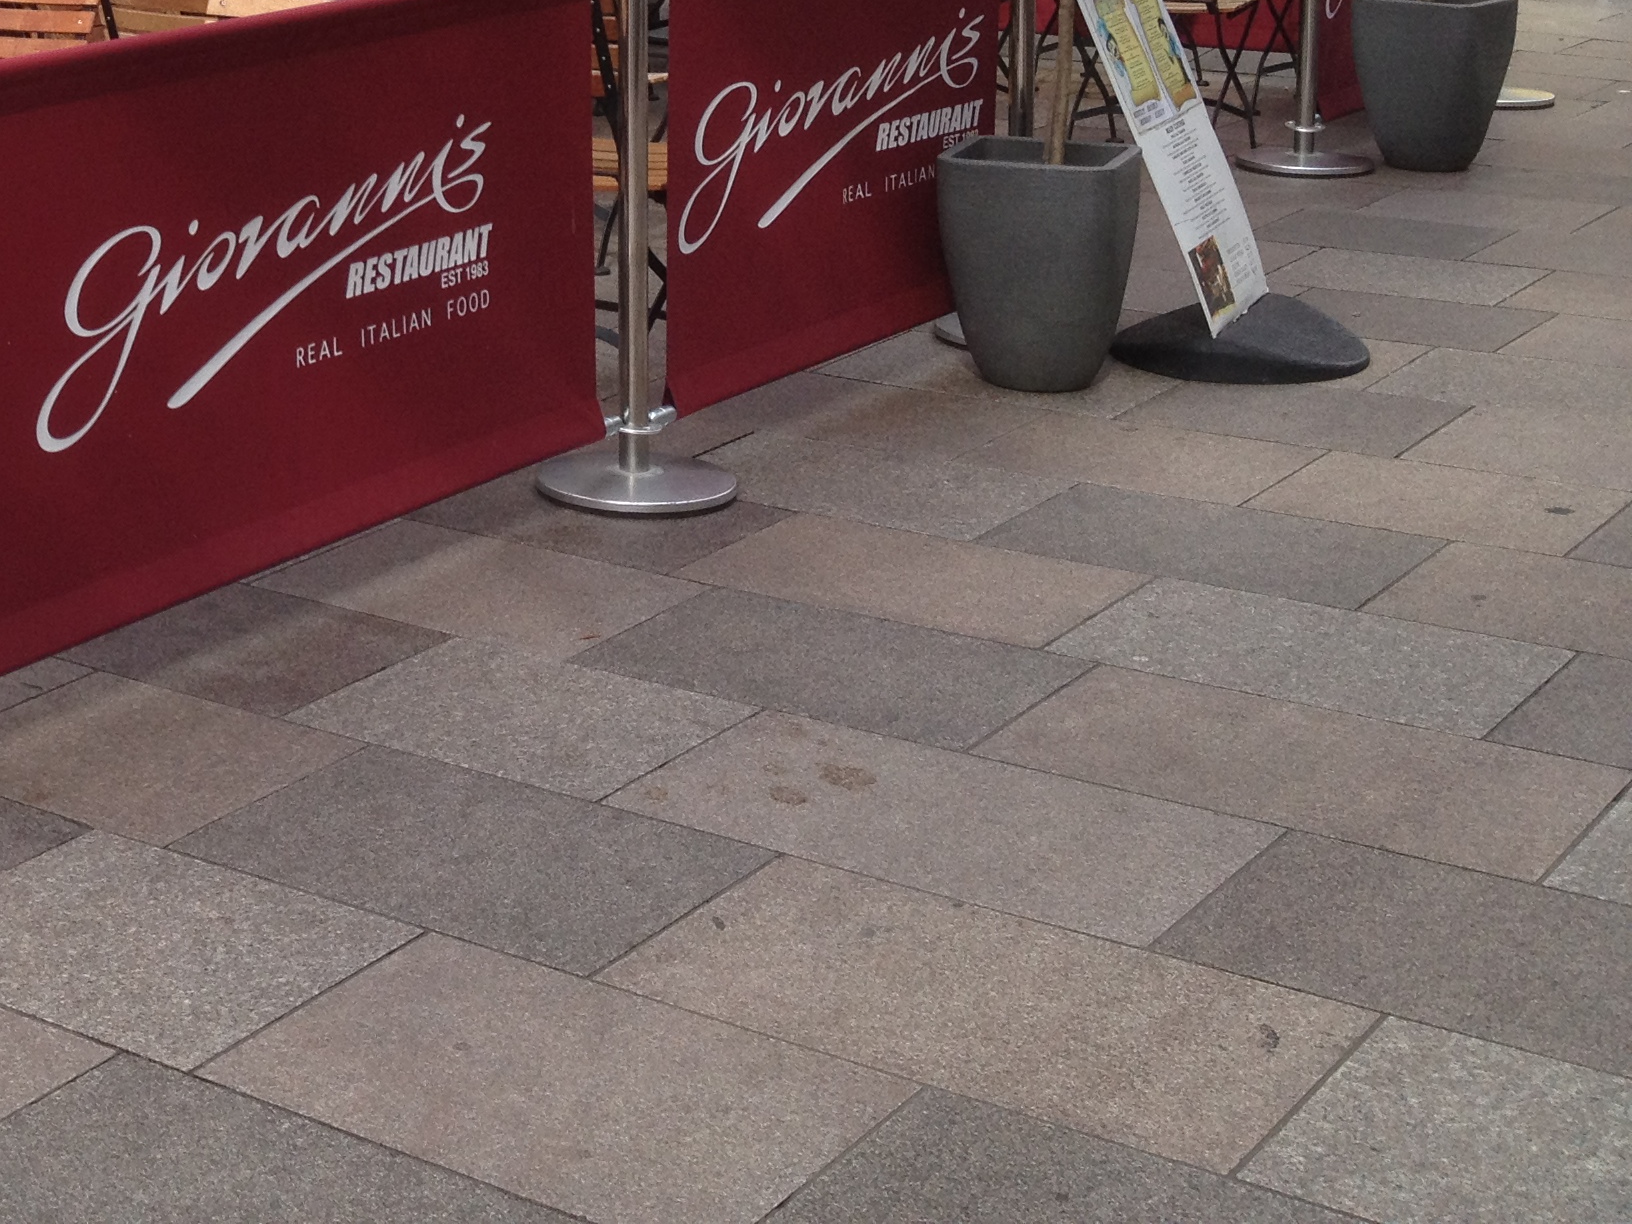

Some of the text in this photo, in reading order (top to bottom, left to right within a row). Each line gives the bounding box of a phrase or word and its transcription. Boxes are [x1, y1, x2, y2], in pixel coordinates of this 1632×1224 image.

[875, 98, 983, 152] RESTAURANT
[842, 164, 935, 205] REAL ITALIAN
[345, 223, 493, 299] RESTAURANT
[441, 260, 489, 289] EST 1983
[295, 289, 491, 368] REAL ITALIAN FOOD
